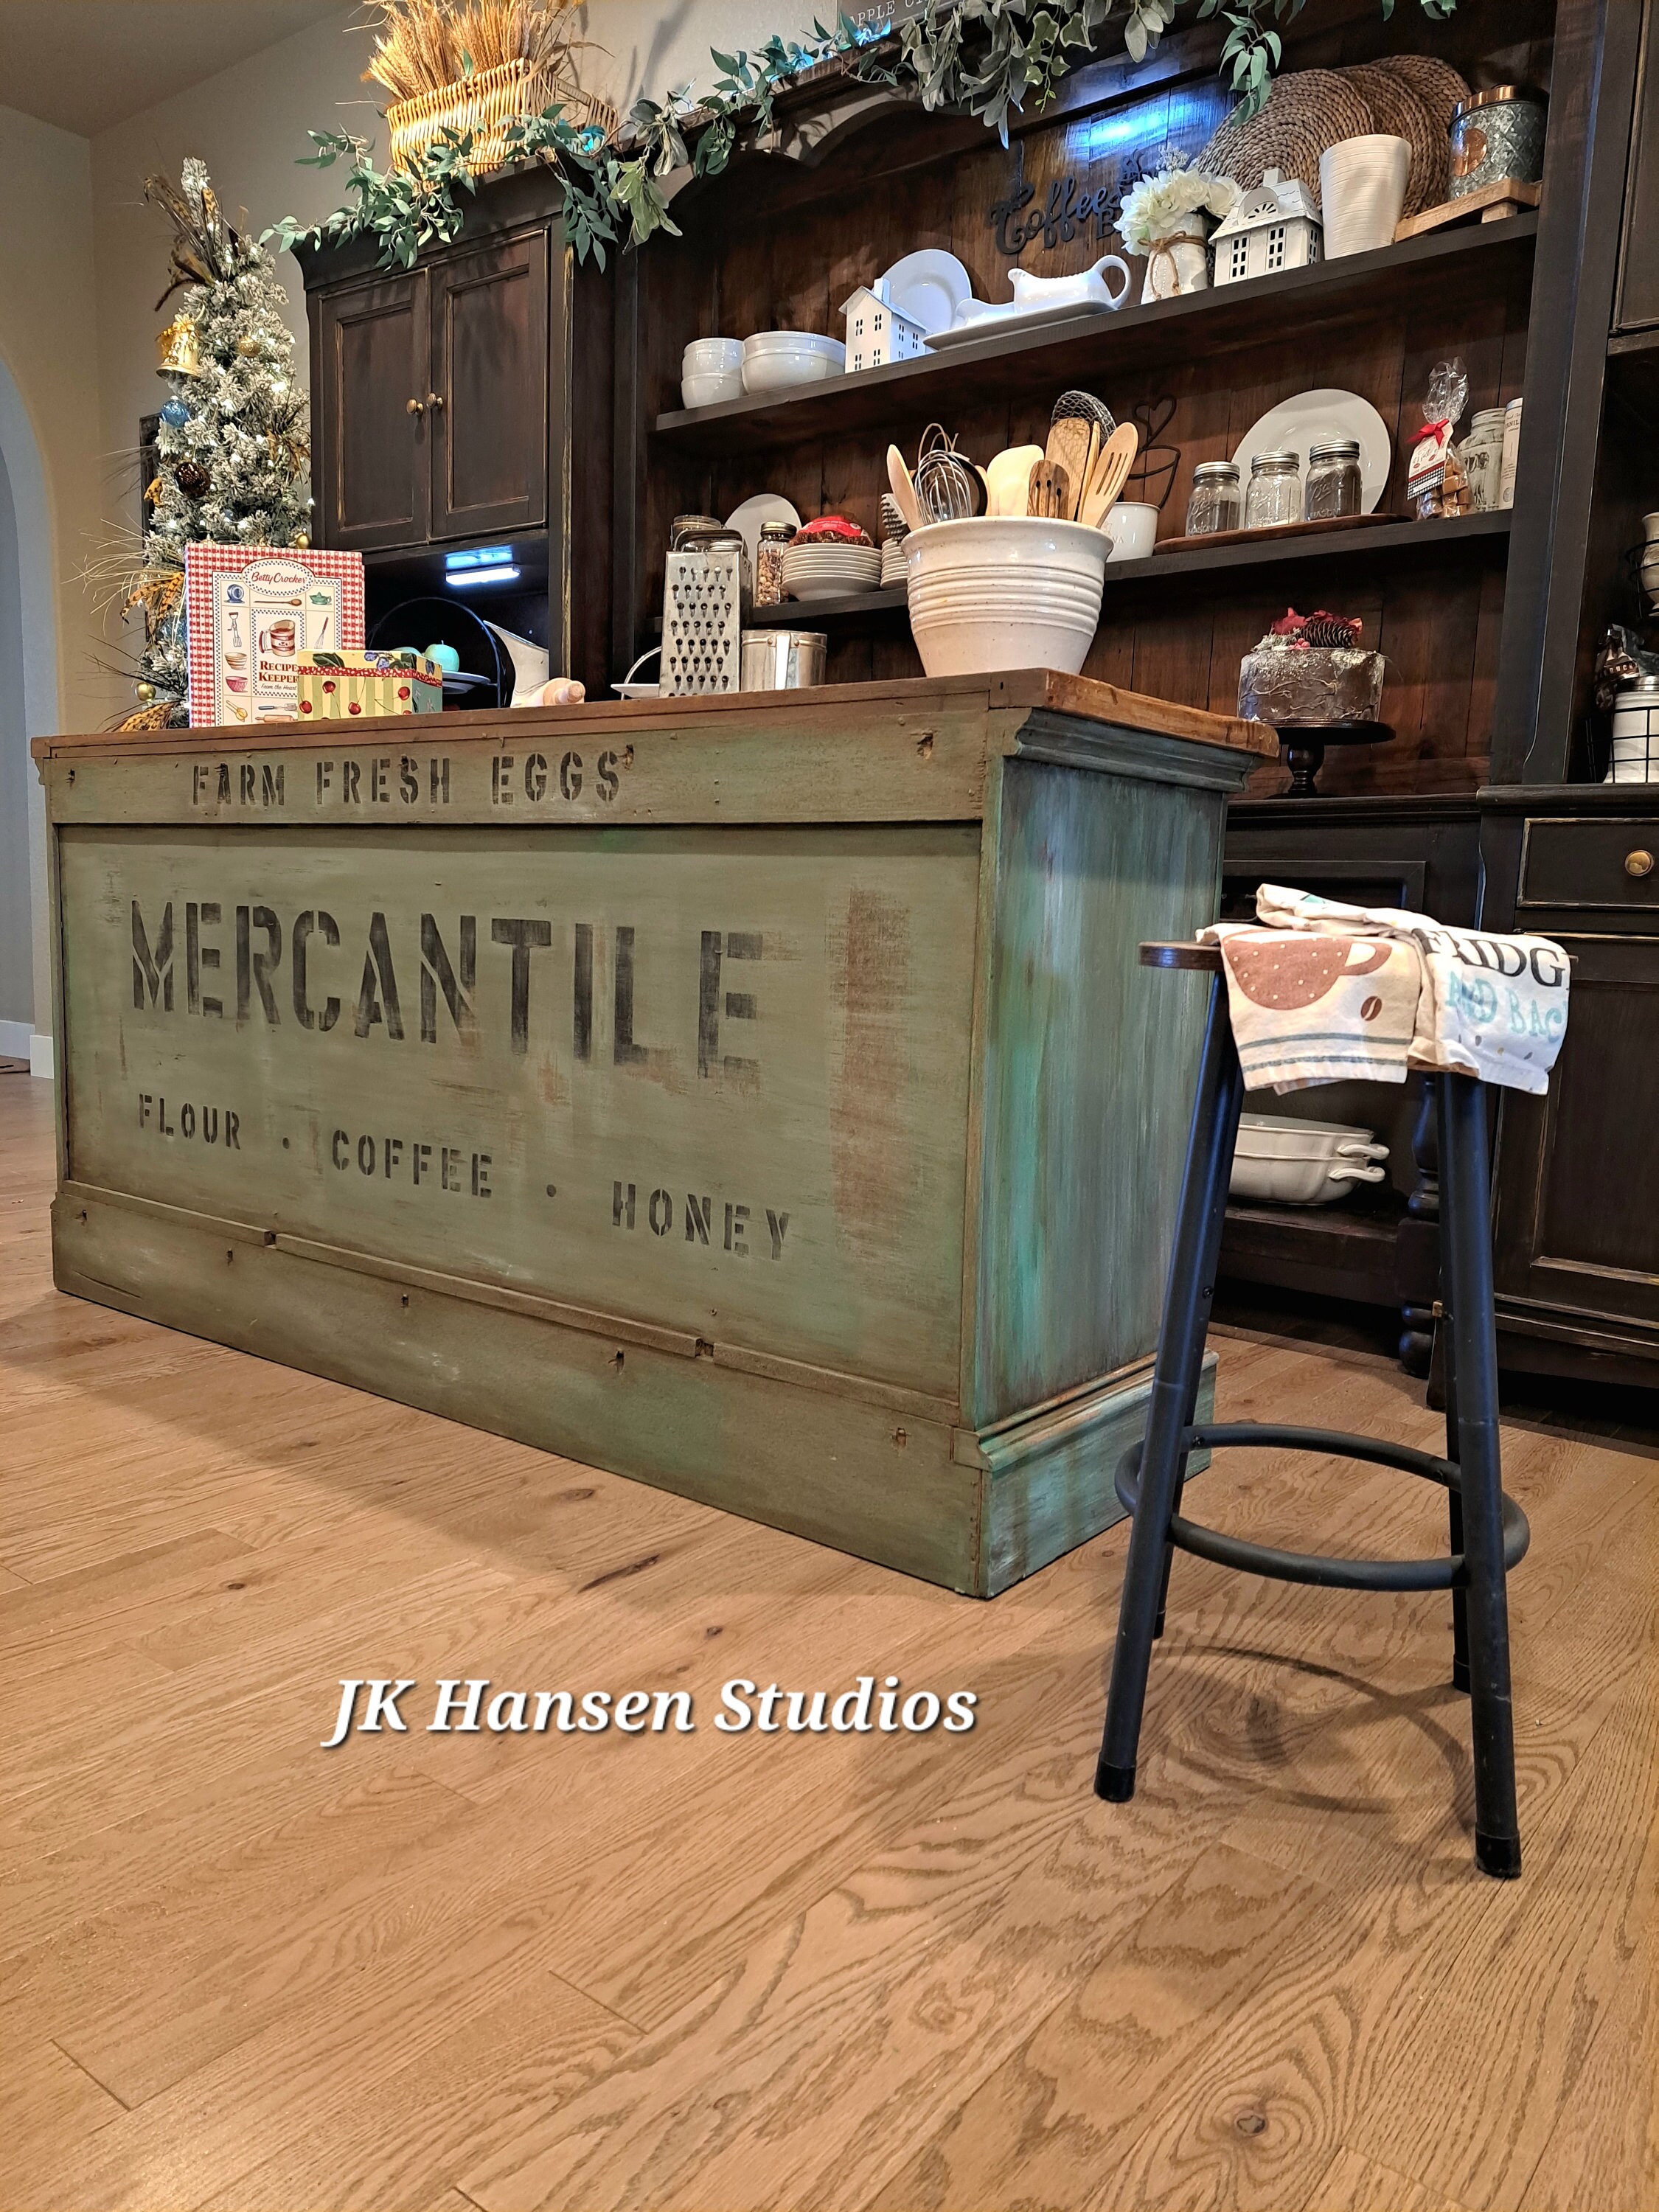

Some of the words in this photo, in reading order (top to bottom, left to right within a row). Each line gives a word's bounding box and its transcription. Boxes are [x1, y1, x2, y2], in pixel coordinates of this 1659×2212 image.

[986, 175, 1110, 254] Coffee
[251, 571, 274, 585] Betty
[273, 572, 305, 584] Crocker
[260, 661, 299, 672] RECIPE
[193, 762, 285, 806] FARM
[316, 756, 451, 805] FRESH
[492, 751, 619, 805] EGGS
[1411, 928, 1569, 987] FRIDG
[131, 900, 762, 1082] MERCANTILE
[1506, 988, 1568, 1043] BAC
[139, 1093, 241, 1150] FLOUR
[332, 1130, 493, 1198] COFFEE
[612, 1181, 790, 1261] HONEY
